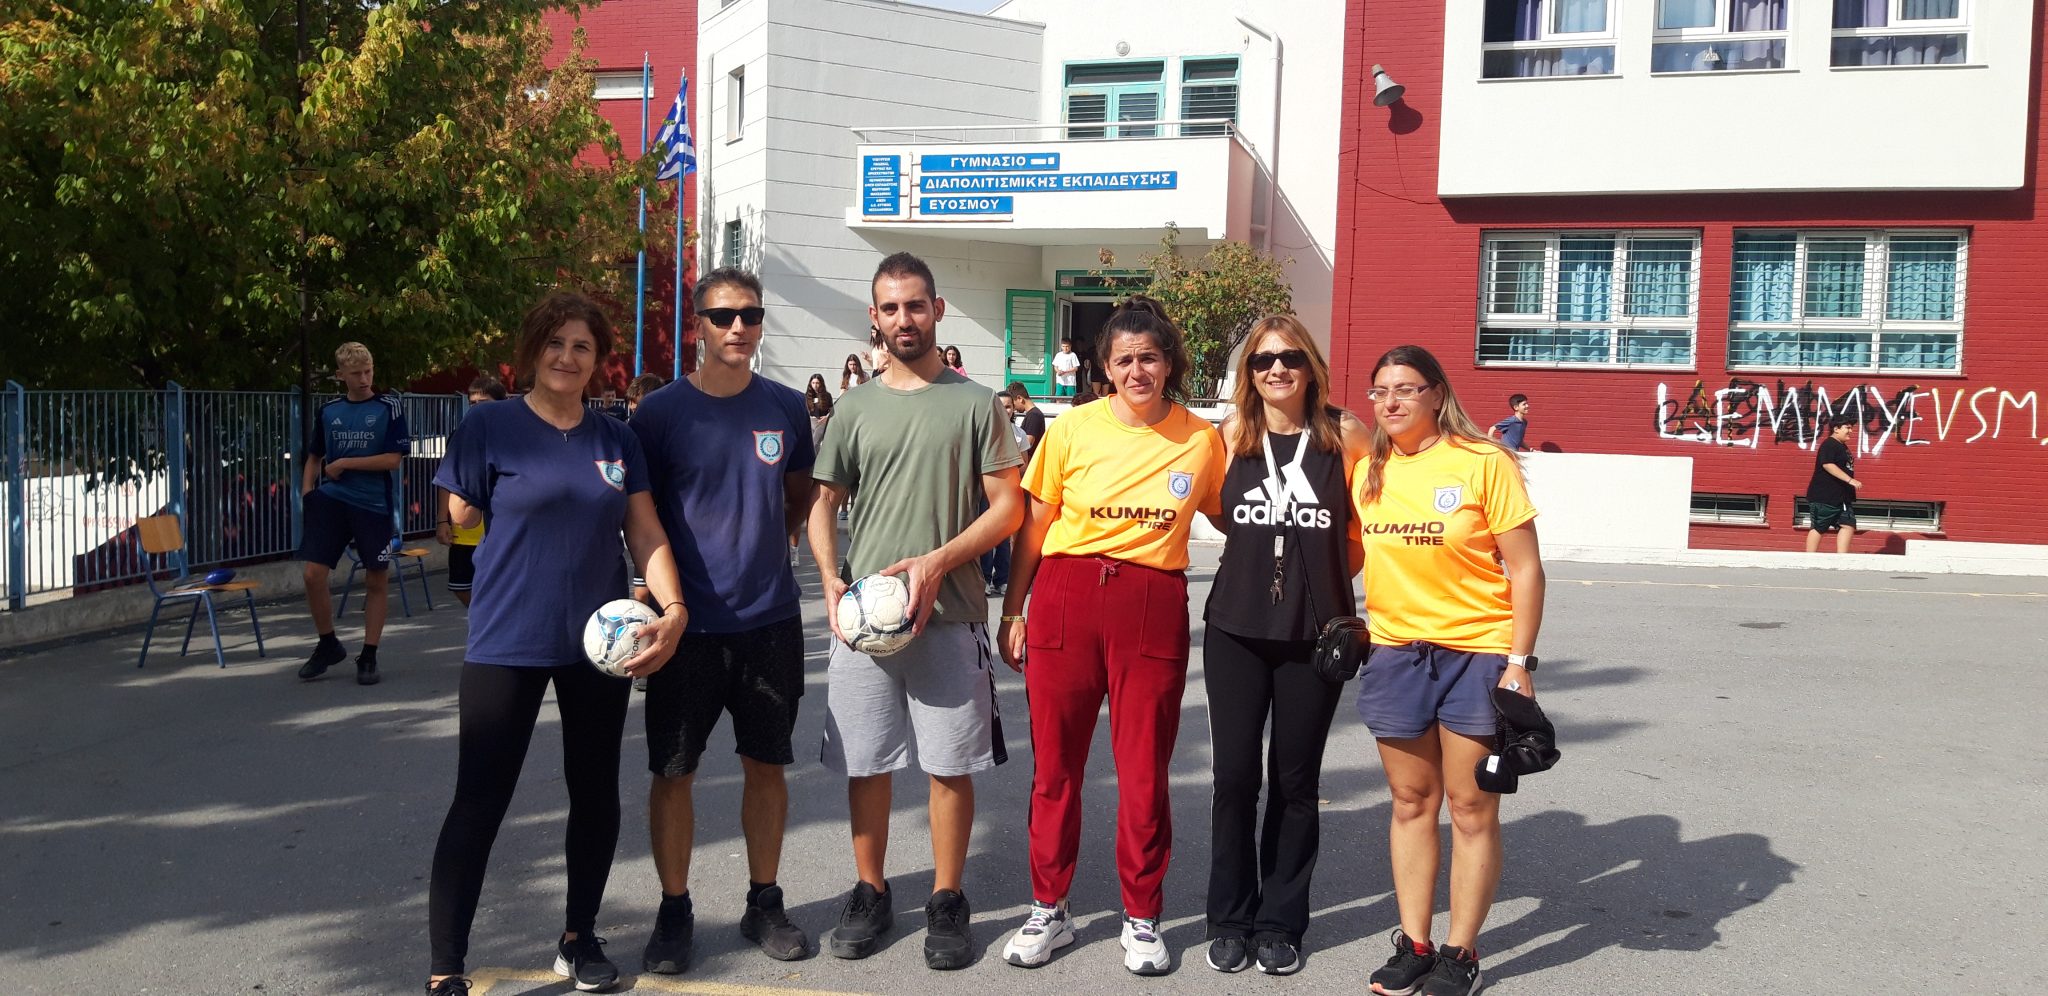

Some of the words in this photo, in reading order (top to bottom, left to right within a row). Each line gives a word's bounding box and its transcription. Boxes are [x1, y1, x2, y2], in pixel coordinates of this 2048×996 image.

[950, 156, 1026, 168] ΓΥΜΝΑΣΙΟ
[925, 176, 1058, 189] ΔΙΑΠΟΛΙΤΙΣΜΙΚΗΣ
[1062, 173, 1171, 188] ΕΚΠΑΙΔΕΥΣΗΣ
[929, 198, 1000, 210] ΕΥΟΣΜΟΥ
[331, 429, 376, 440] Emirates
[1090, 506, 1177, 522] KUMHO
[1137, 520, 1172, 531] TIRE
[1362, 521, 1445, 537] KUMHO
[1402, 535, 1444, 546] TIRE
